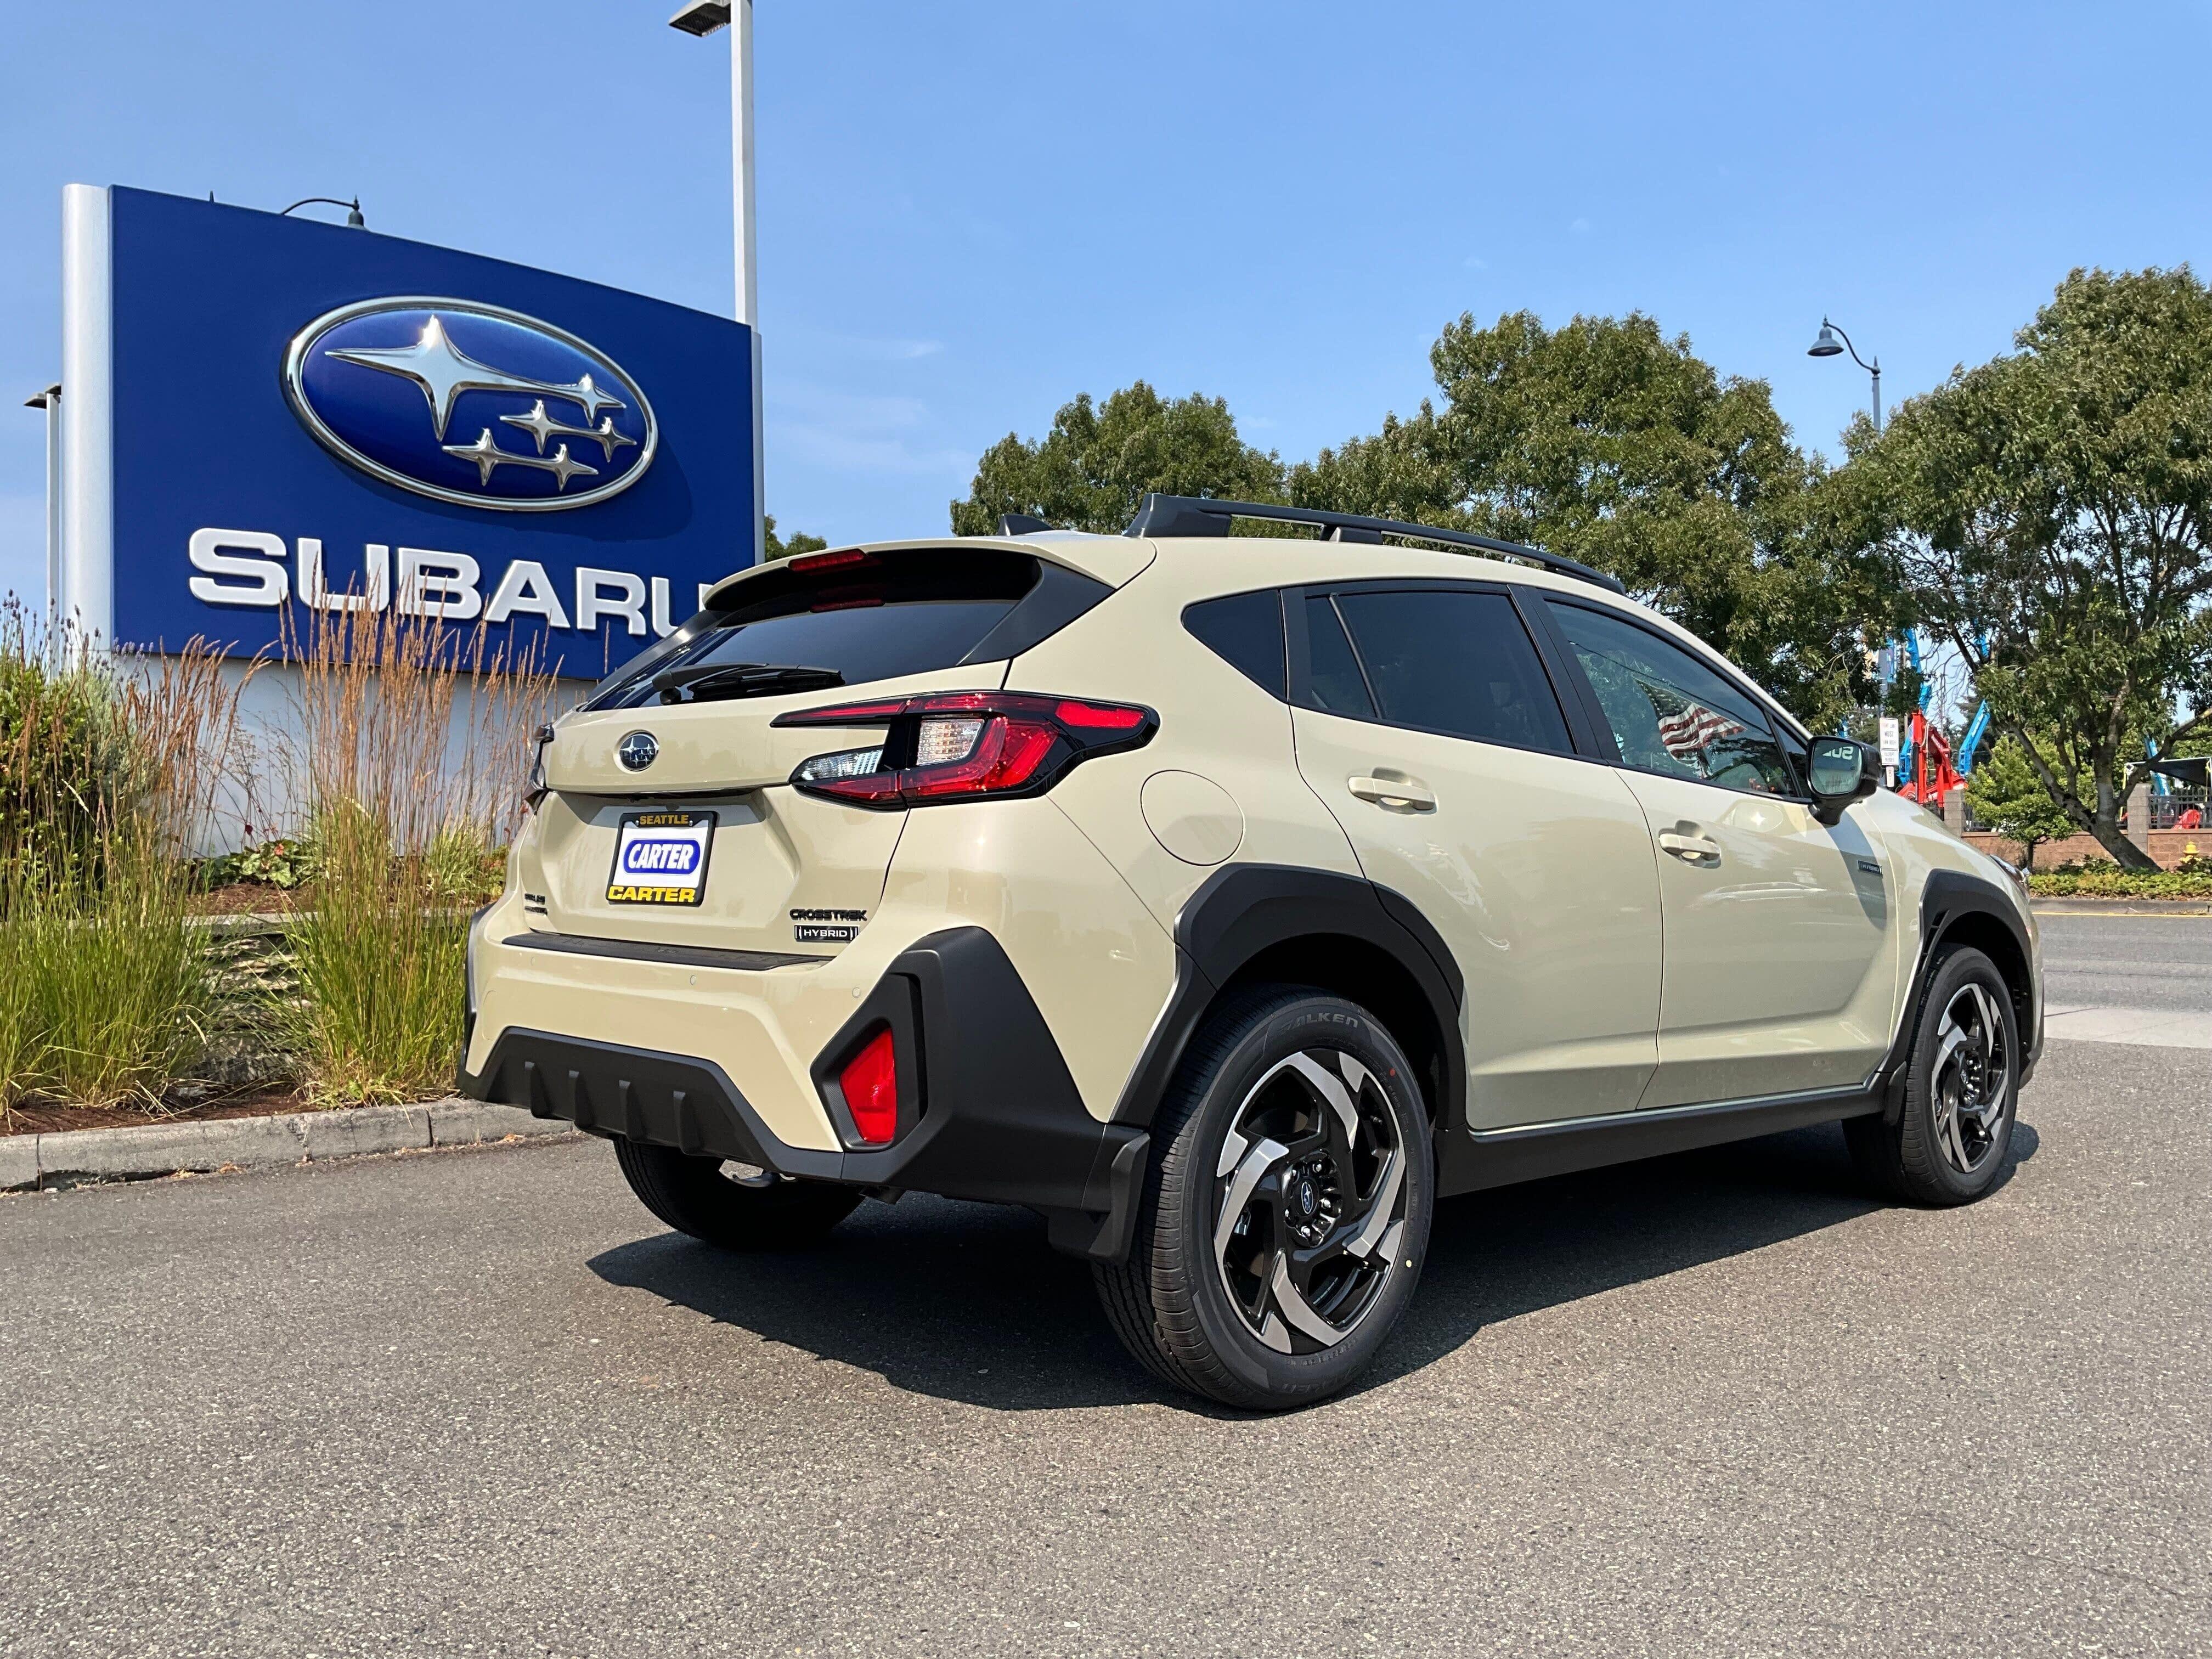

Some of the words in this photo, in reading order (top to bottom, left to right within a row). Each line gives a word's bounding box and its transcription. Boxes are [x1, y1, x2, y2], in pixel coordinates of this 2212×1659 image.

[189, 528, 714, 638] SUBARU
[640, 814, 689, 825] SEATTLE
[628, 843, 694, 869] CARTER
[608, 885, 696, 902] CARTER
[789, 909, 867, 921] CROSSTREK
[804, 929, 847, 937] HYBRID
